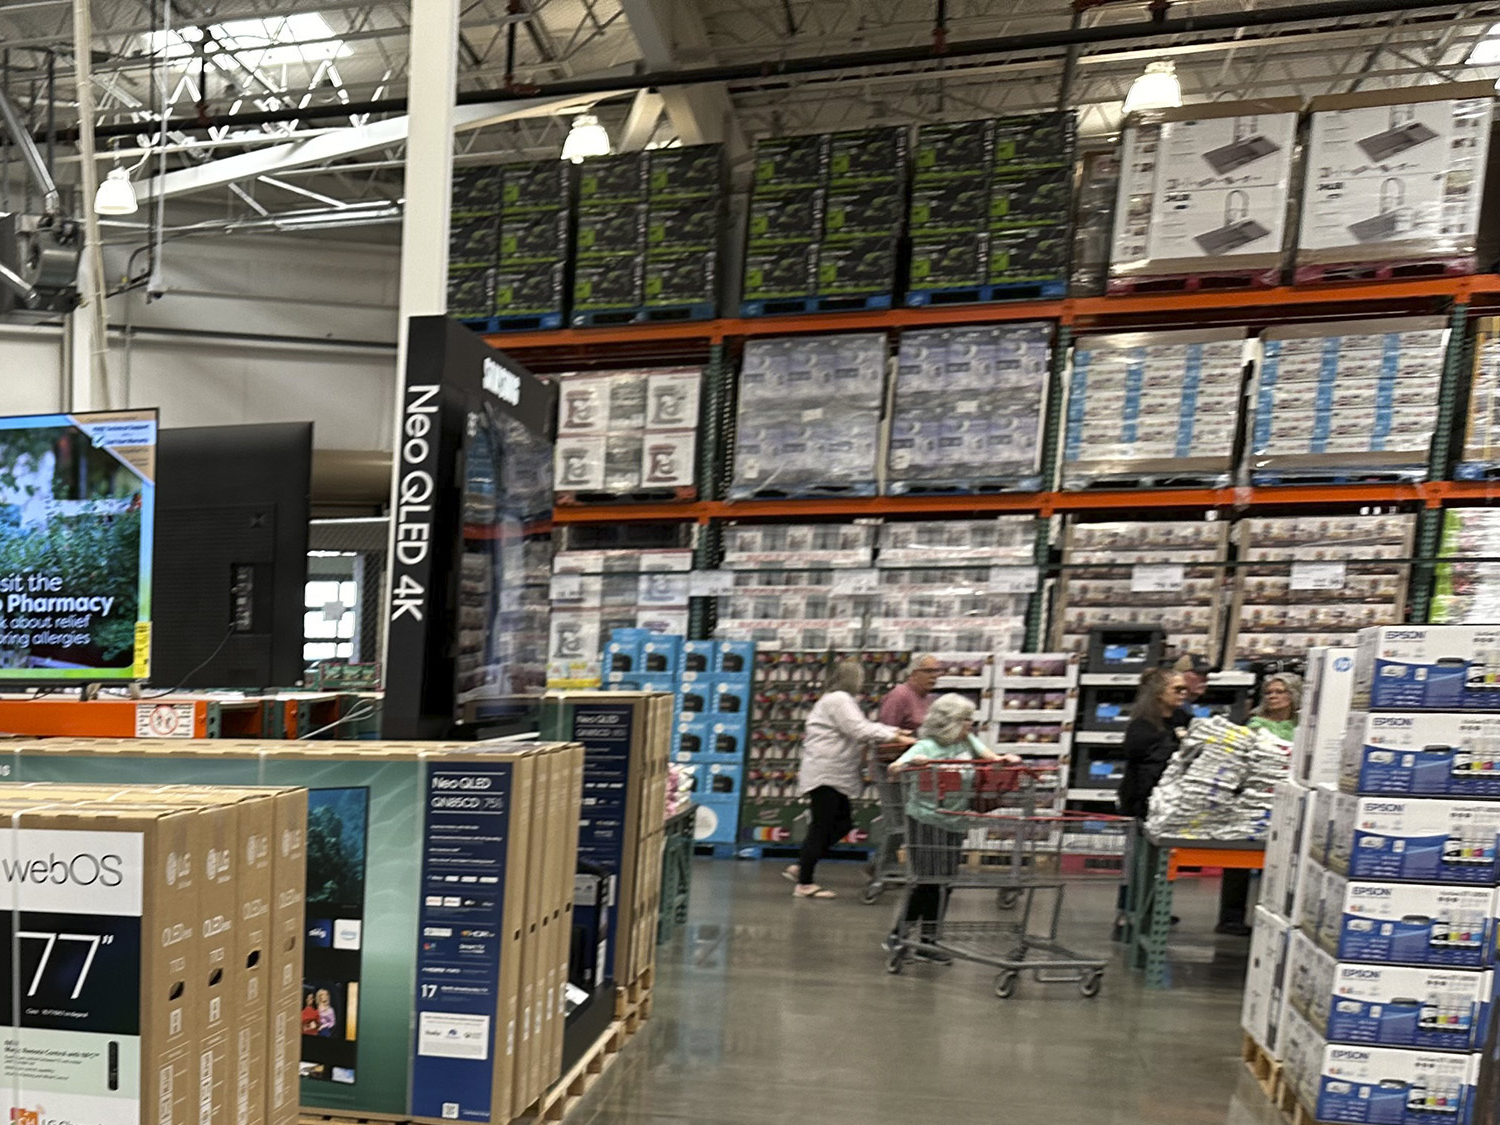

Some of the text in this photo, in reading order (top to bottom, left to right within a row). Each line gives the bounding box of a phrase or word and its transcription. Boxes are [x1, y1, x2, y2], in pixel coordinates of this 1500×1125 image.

[391, 384, 440, 622] Neo QLED 4K
[27, 574, 63, 592] the
[7, 594, 114, 617] Pharmacy
[10, 615, 52, 629] about
[54, 614, 92, 629] relief
[32, 632, 91, 648] allergies
[1385, 630, 1426, 641] EPSON
[1372, 717, 1413, 727] EPSON
[431, 777, 492, 790] Neo QLED
[1364, 803, 1405, 813] EPSON
[176, 851, 191, 877] LG
[215, 849, 230, 873] LG
[2, 852, 123, 887] webOS
[1351, 886, 1392, 897] EPSON
[1341, 969, 1382, 979] EPSON
[421, 984, 438, 999] 17
[1330, 1050, 1371, 1060] EPSON
